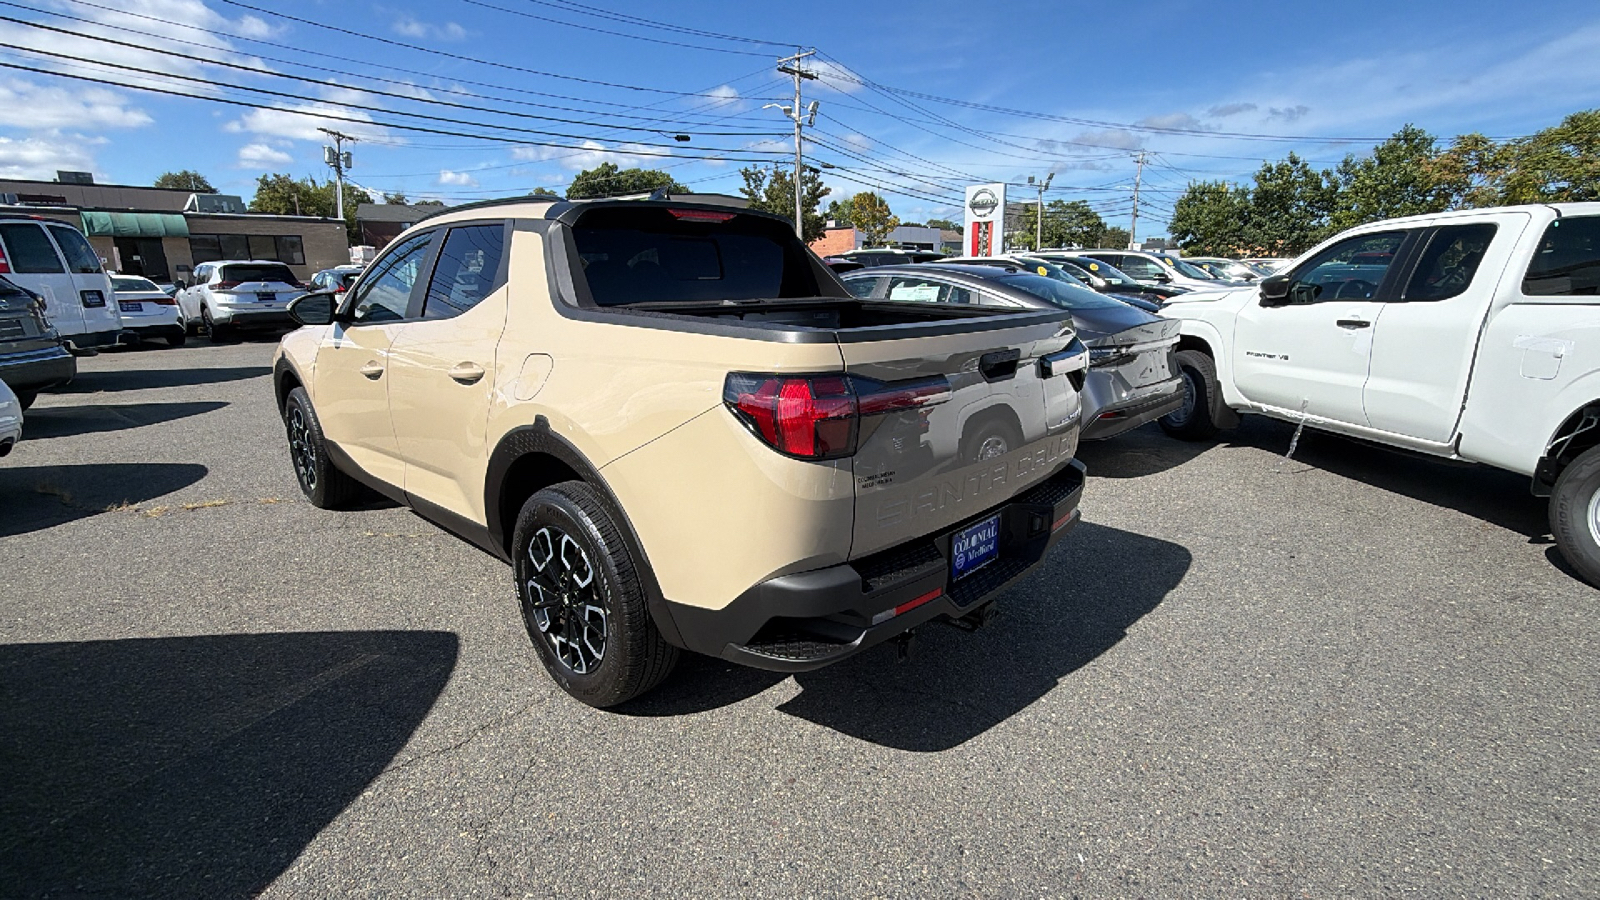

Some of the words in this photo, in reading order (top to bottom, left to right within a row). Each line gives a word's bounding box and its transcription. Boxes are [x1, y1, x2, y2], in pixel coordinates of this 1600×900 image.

[876, 461, 1009, 528] SANTA
[954, 525, 997, 555] COLONIAL
[967, 540, 995, 562] Medford
